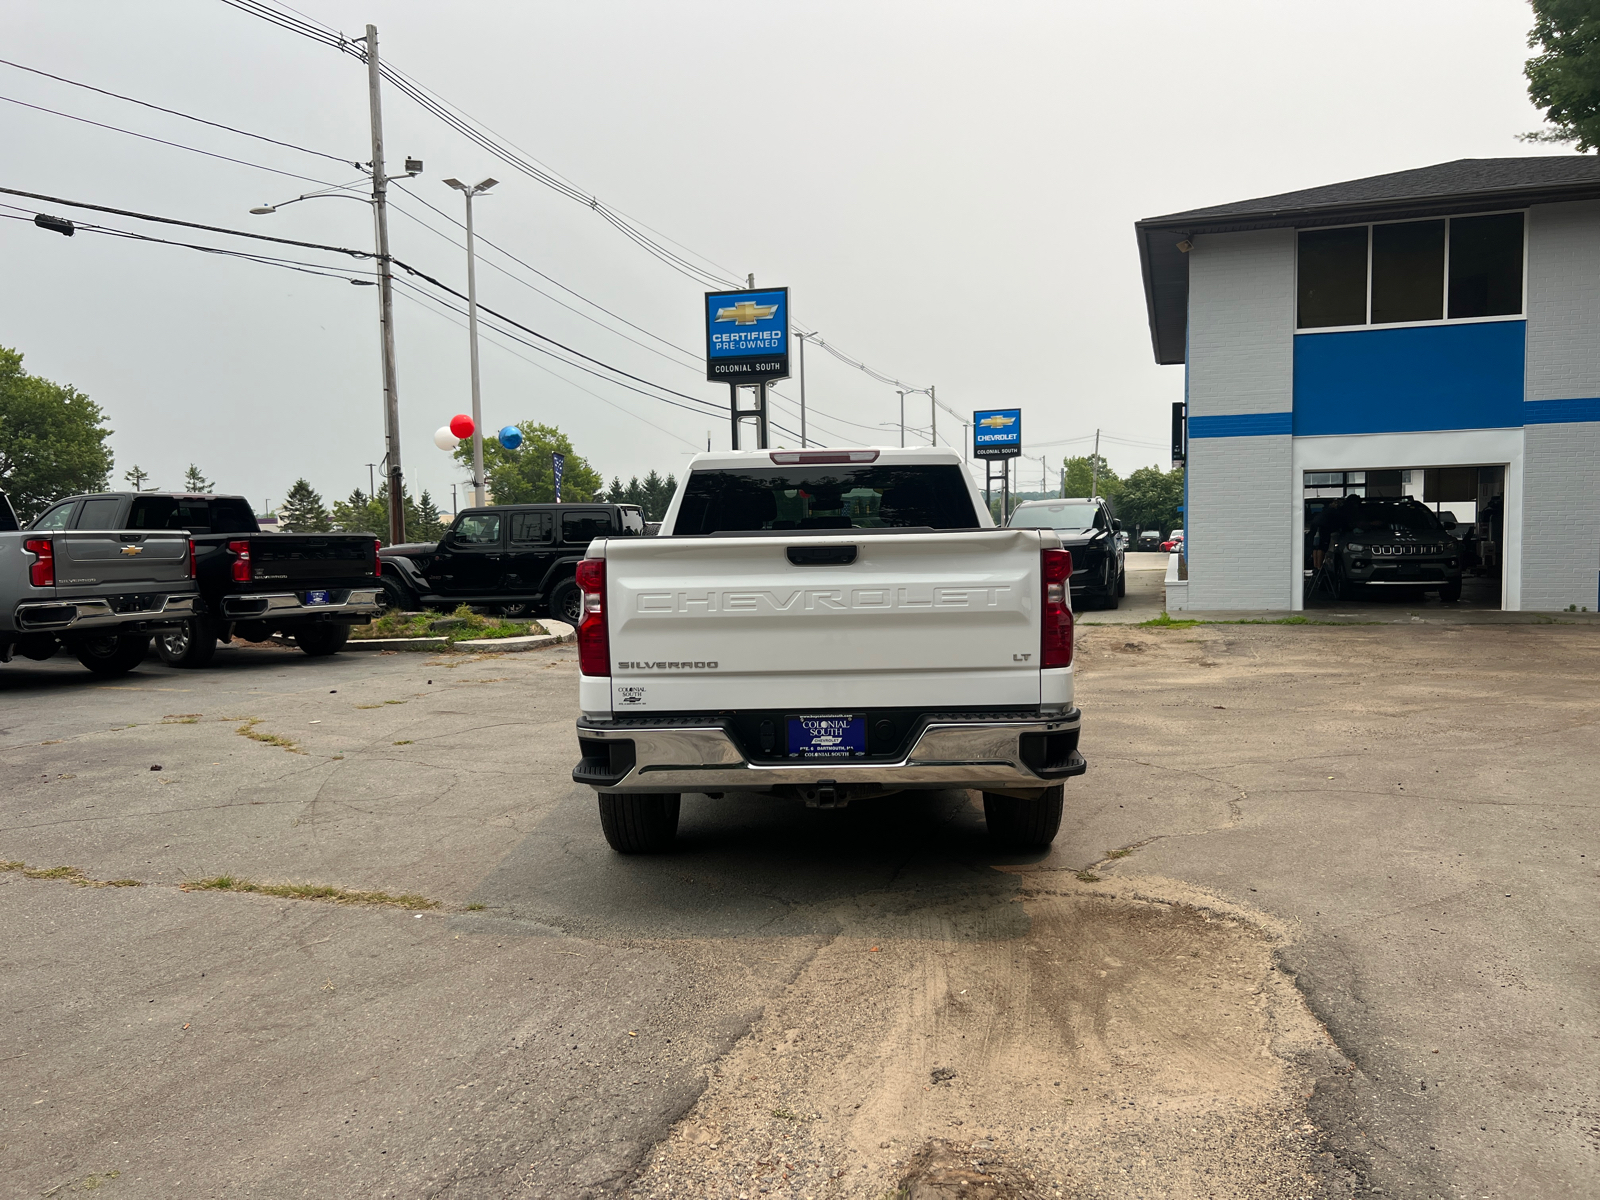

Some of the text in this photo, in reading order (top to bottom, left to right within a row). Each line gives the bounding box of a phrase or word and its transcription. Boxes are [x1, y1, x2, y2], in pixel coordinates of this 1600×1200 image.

[712, 331, 781, 342] CERTIFIED
[716, 339, 778, 350] PRE-OWNED
[715, 362, 780, 373] COLONIAL SOUTH
[977, 433, 1017, 442] CHEVROLET
[636, 586, 1011, 613] CHEVROLET
[1013, 653, 1032, 662] LT
[618, 661, 719, 669] SILVERADO
[802, 720, 850, 729] COLONIAL
[809, 728, 843, 736] SOUTH
